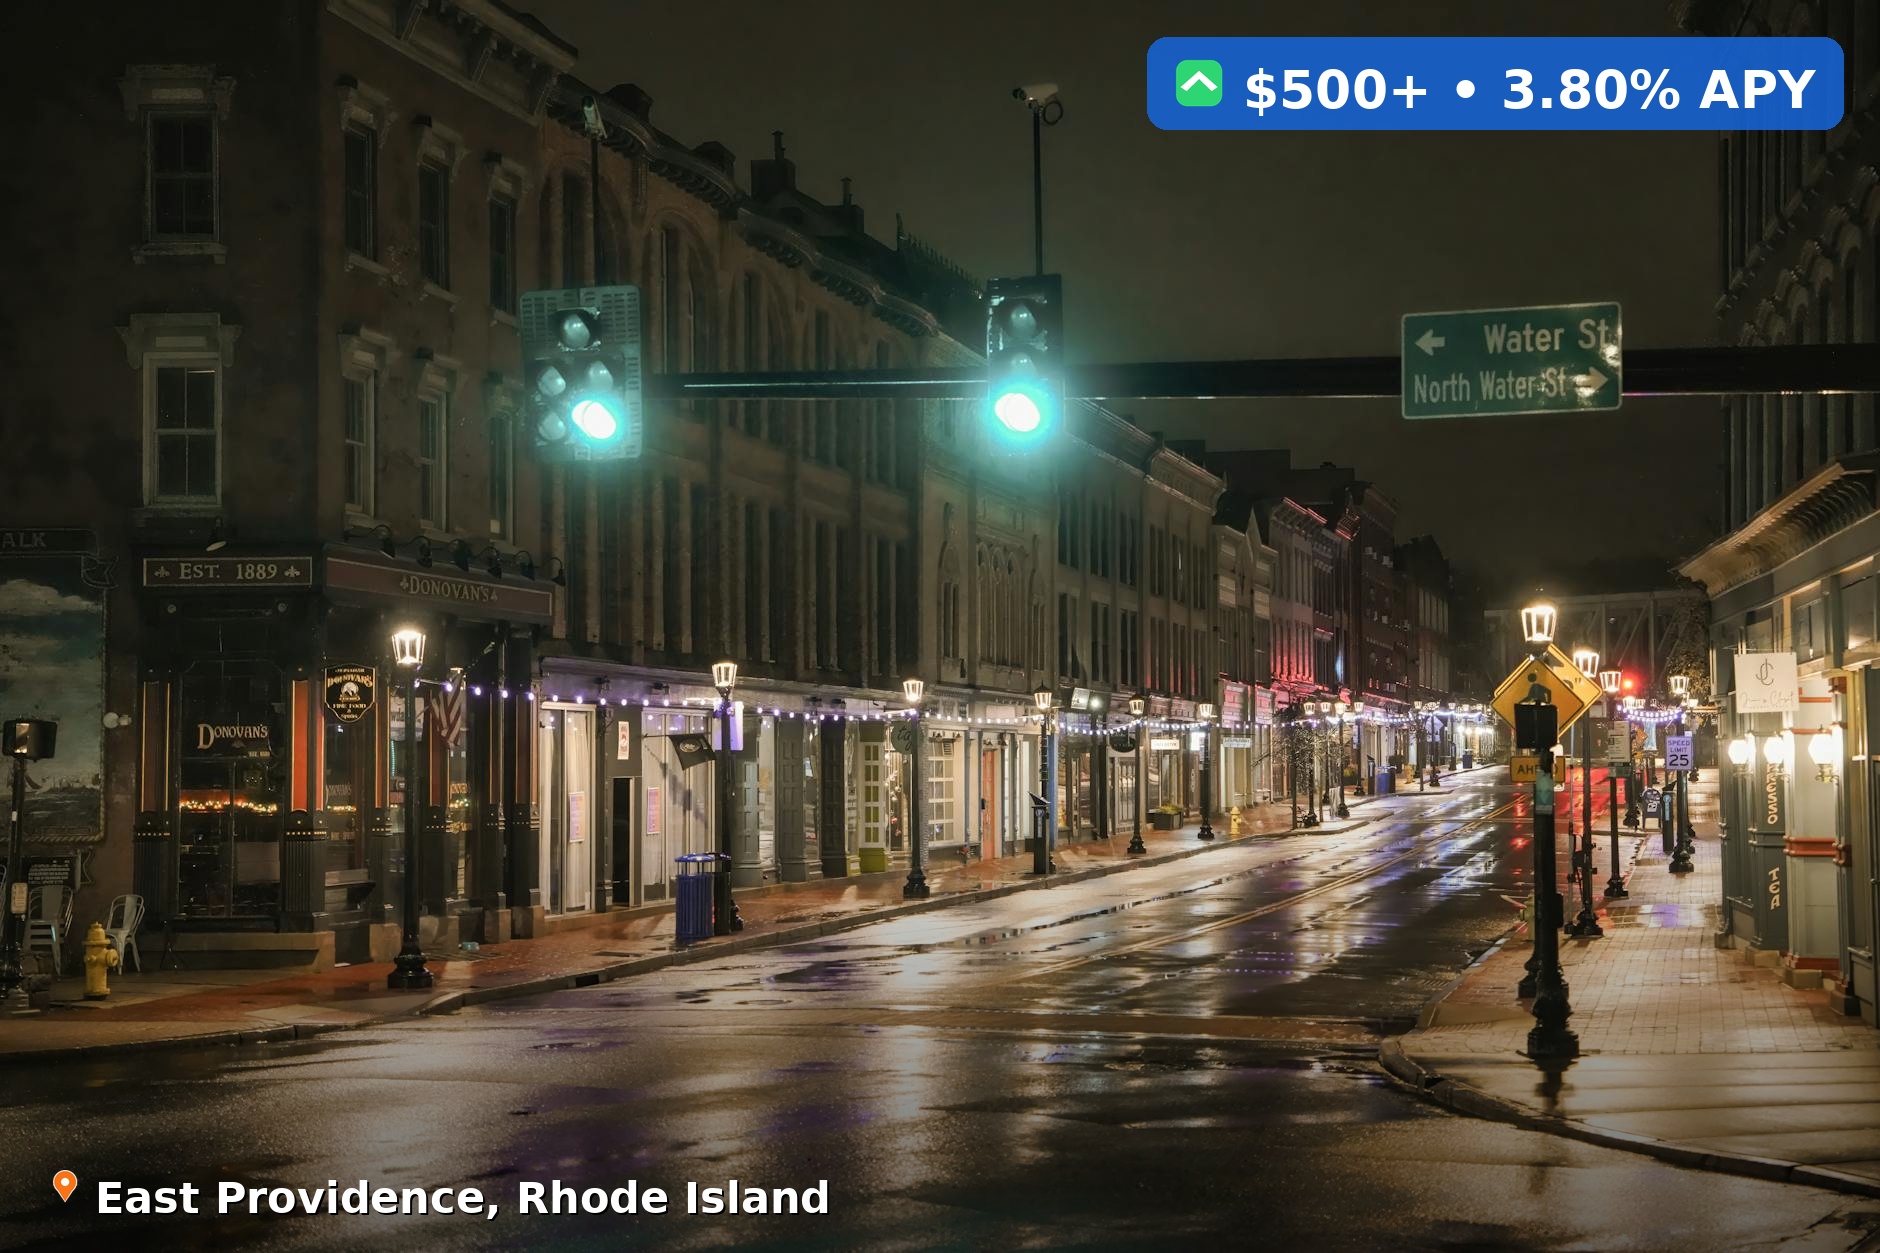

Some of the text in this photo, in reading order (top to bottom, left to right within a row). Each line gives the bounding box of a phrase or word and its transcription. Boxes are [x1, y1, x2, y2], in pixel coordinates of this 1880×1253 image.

[1484, 318, 1610, 354] Water St
[1414, 367, 1567, 404] North Water St
[179, 563, 278, 580] EST. 1889
[410, 576, 489, 602] DONOVAN'S
[197, 723, 269, 750] DONOVAN'S
[1669, 754, 1689, 767] 25
[1768, 866, 1782, 911] TEA
